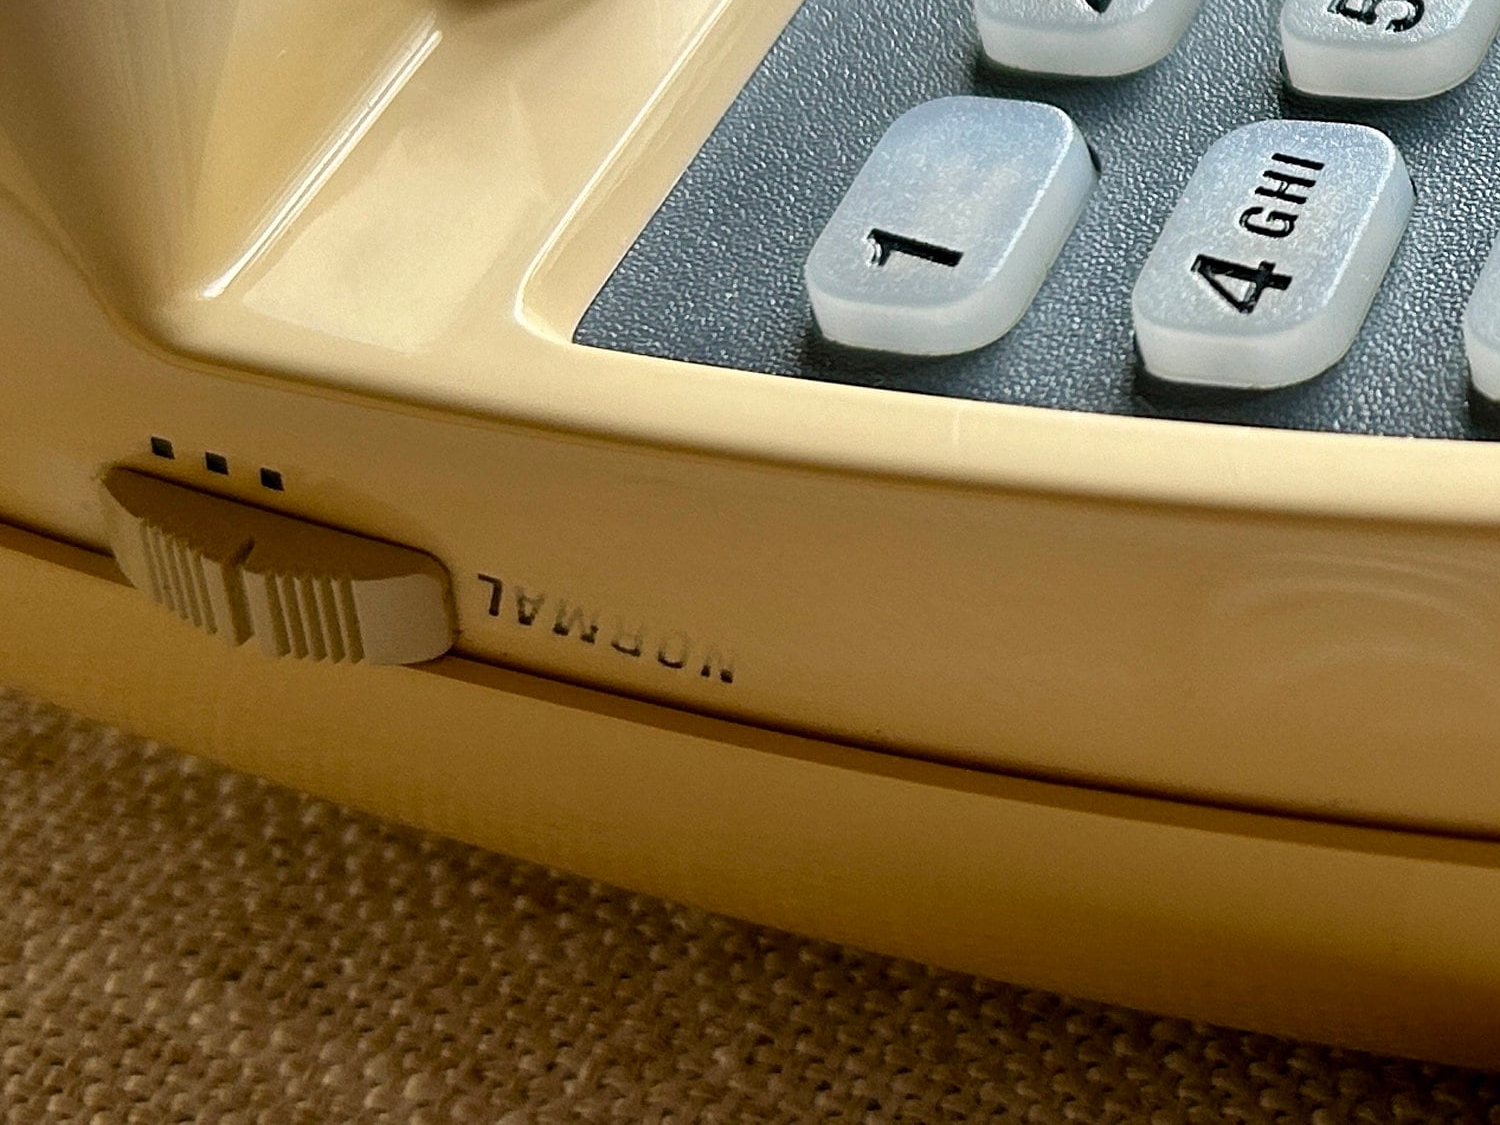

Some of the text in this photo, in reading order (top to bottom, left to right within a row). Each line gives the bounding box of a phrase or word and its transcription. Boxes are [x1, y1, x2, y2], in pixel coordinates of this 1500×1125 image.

[866, 227, 964, 268] 1
[1190, 152, 1325, 315] 4 GHI
[476, 573, 738, 684] NORMAL
